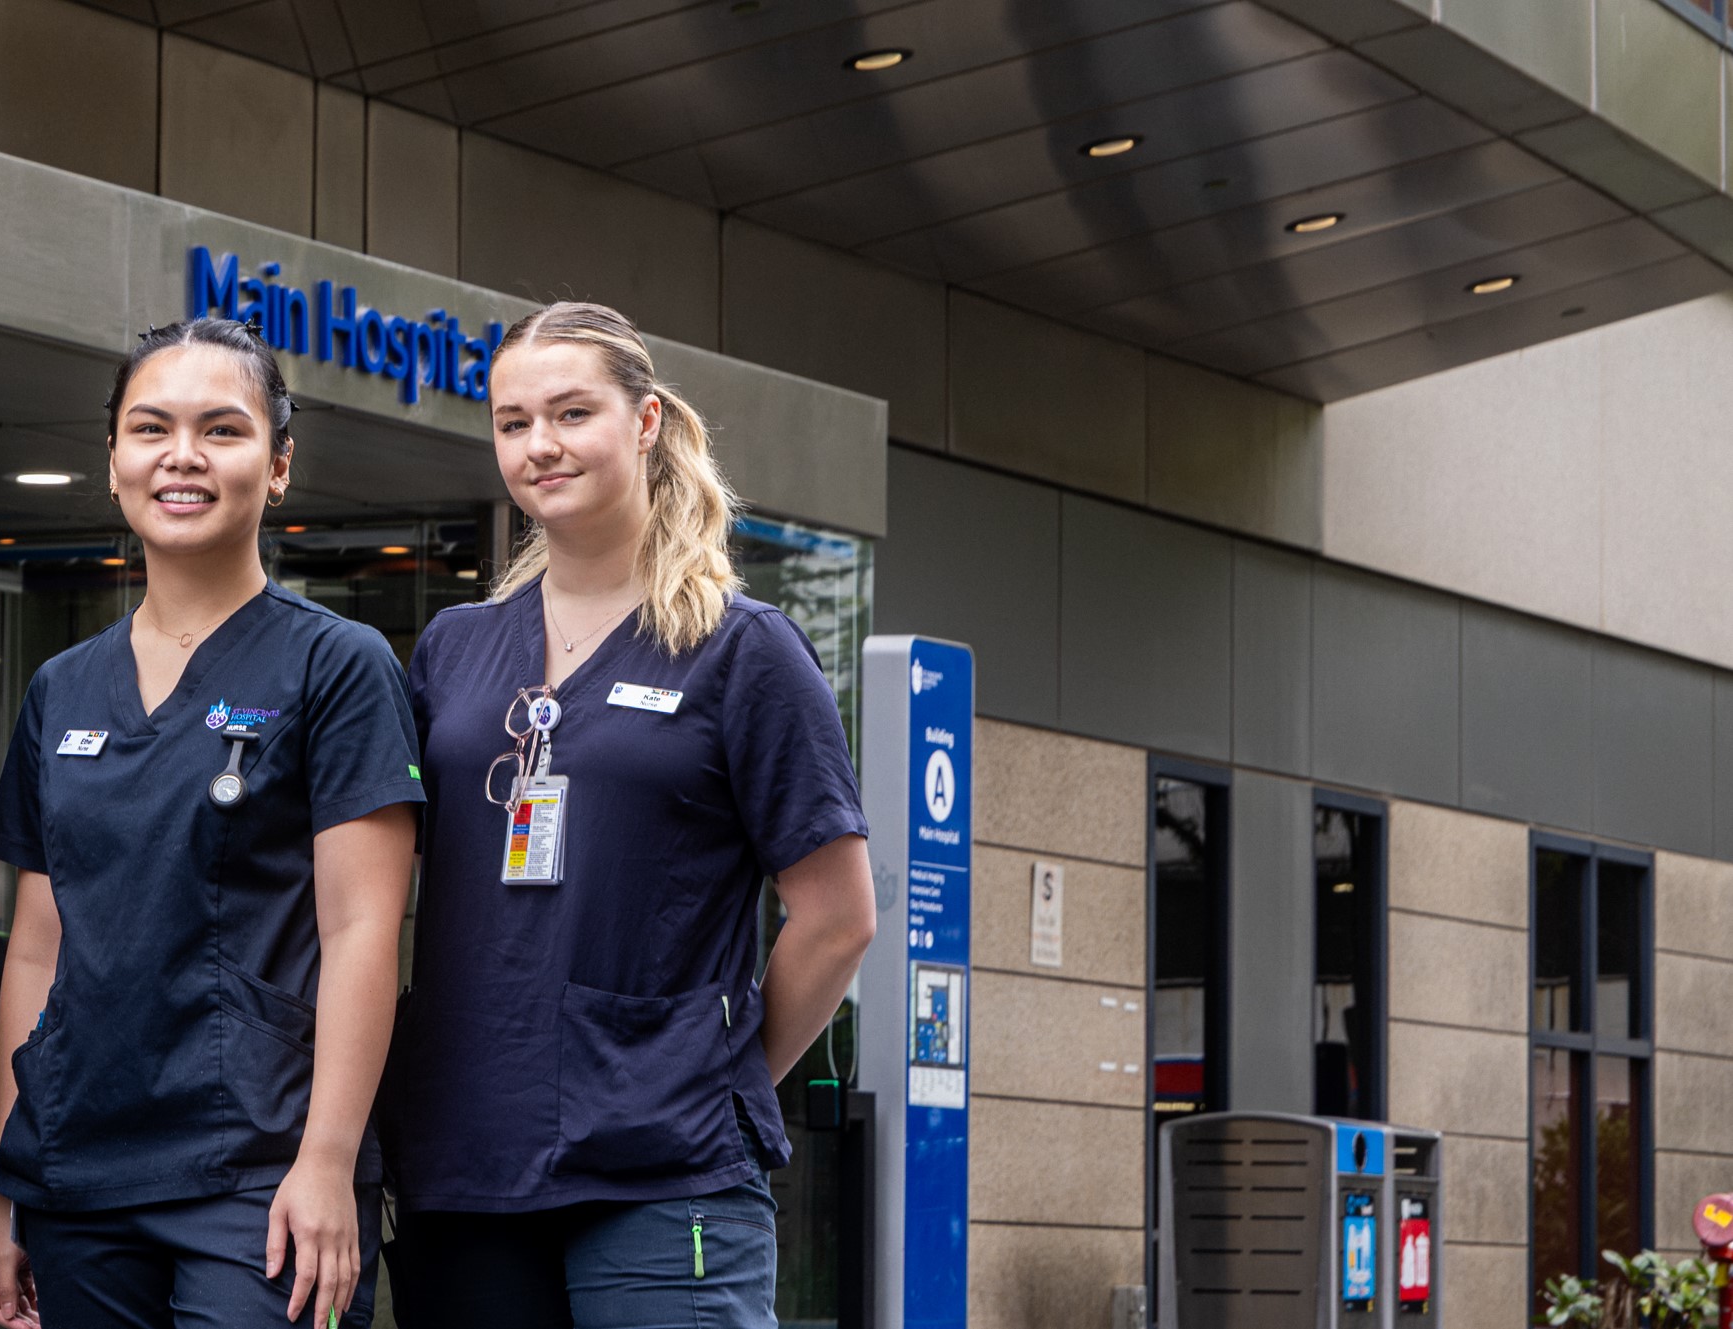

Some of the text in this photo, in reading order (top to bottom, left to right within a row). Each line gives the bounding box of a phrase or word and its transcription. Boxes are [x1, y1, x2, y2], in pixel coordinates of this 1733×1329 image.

[188, 246, 309, 354] Main
[640, 700, 657, 708] Nurse
[643, 694, 661, 702] Kate
[230, 713, 266, 723] HOSPITAL
[226, 724, 247, 732] NURSE
[925, 726, 954, 750] Building
[933, 764, 947, 807] A
[918, 825, 960, 845] Main Hospital
